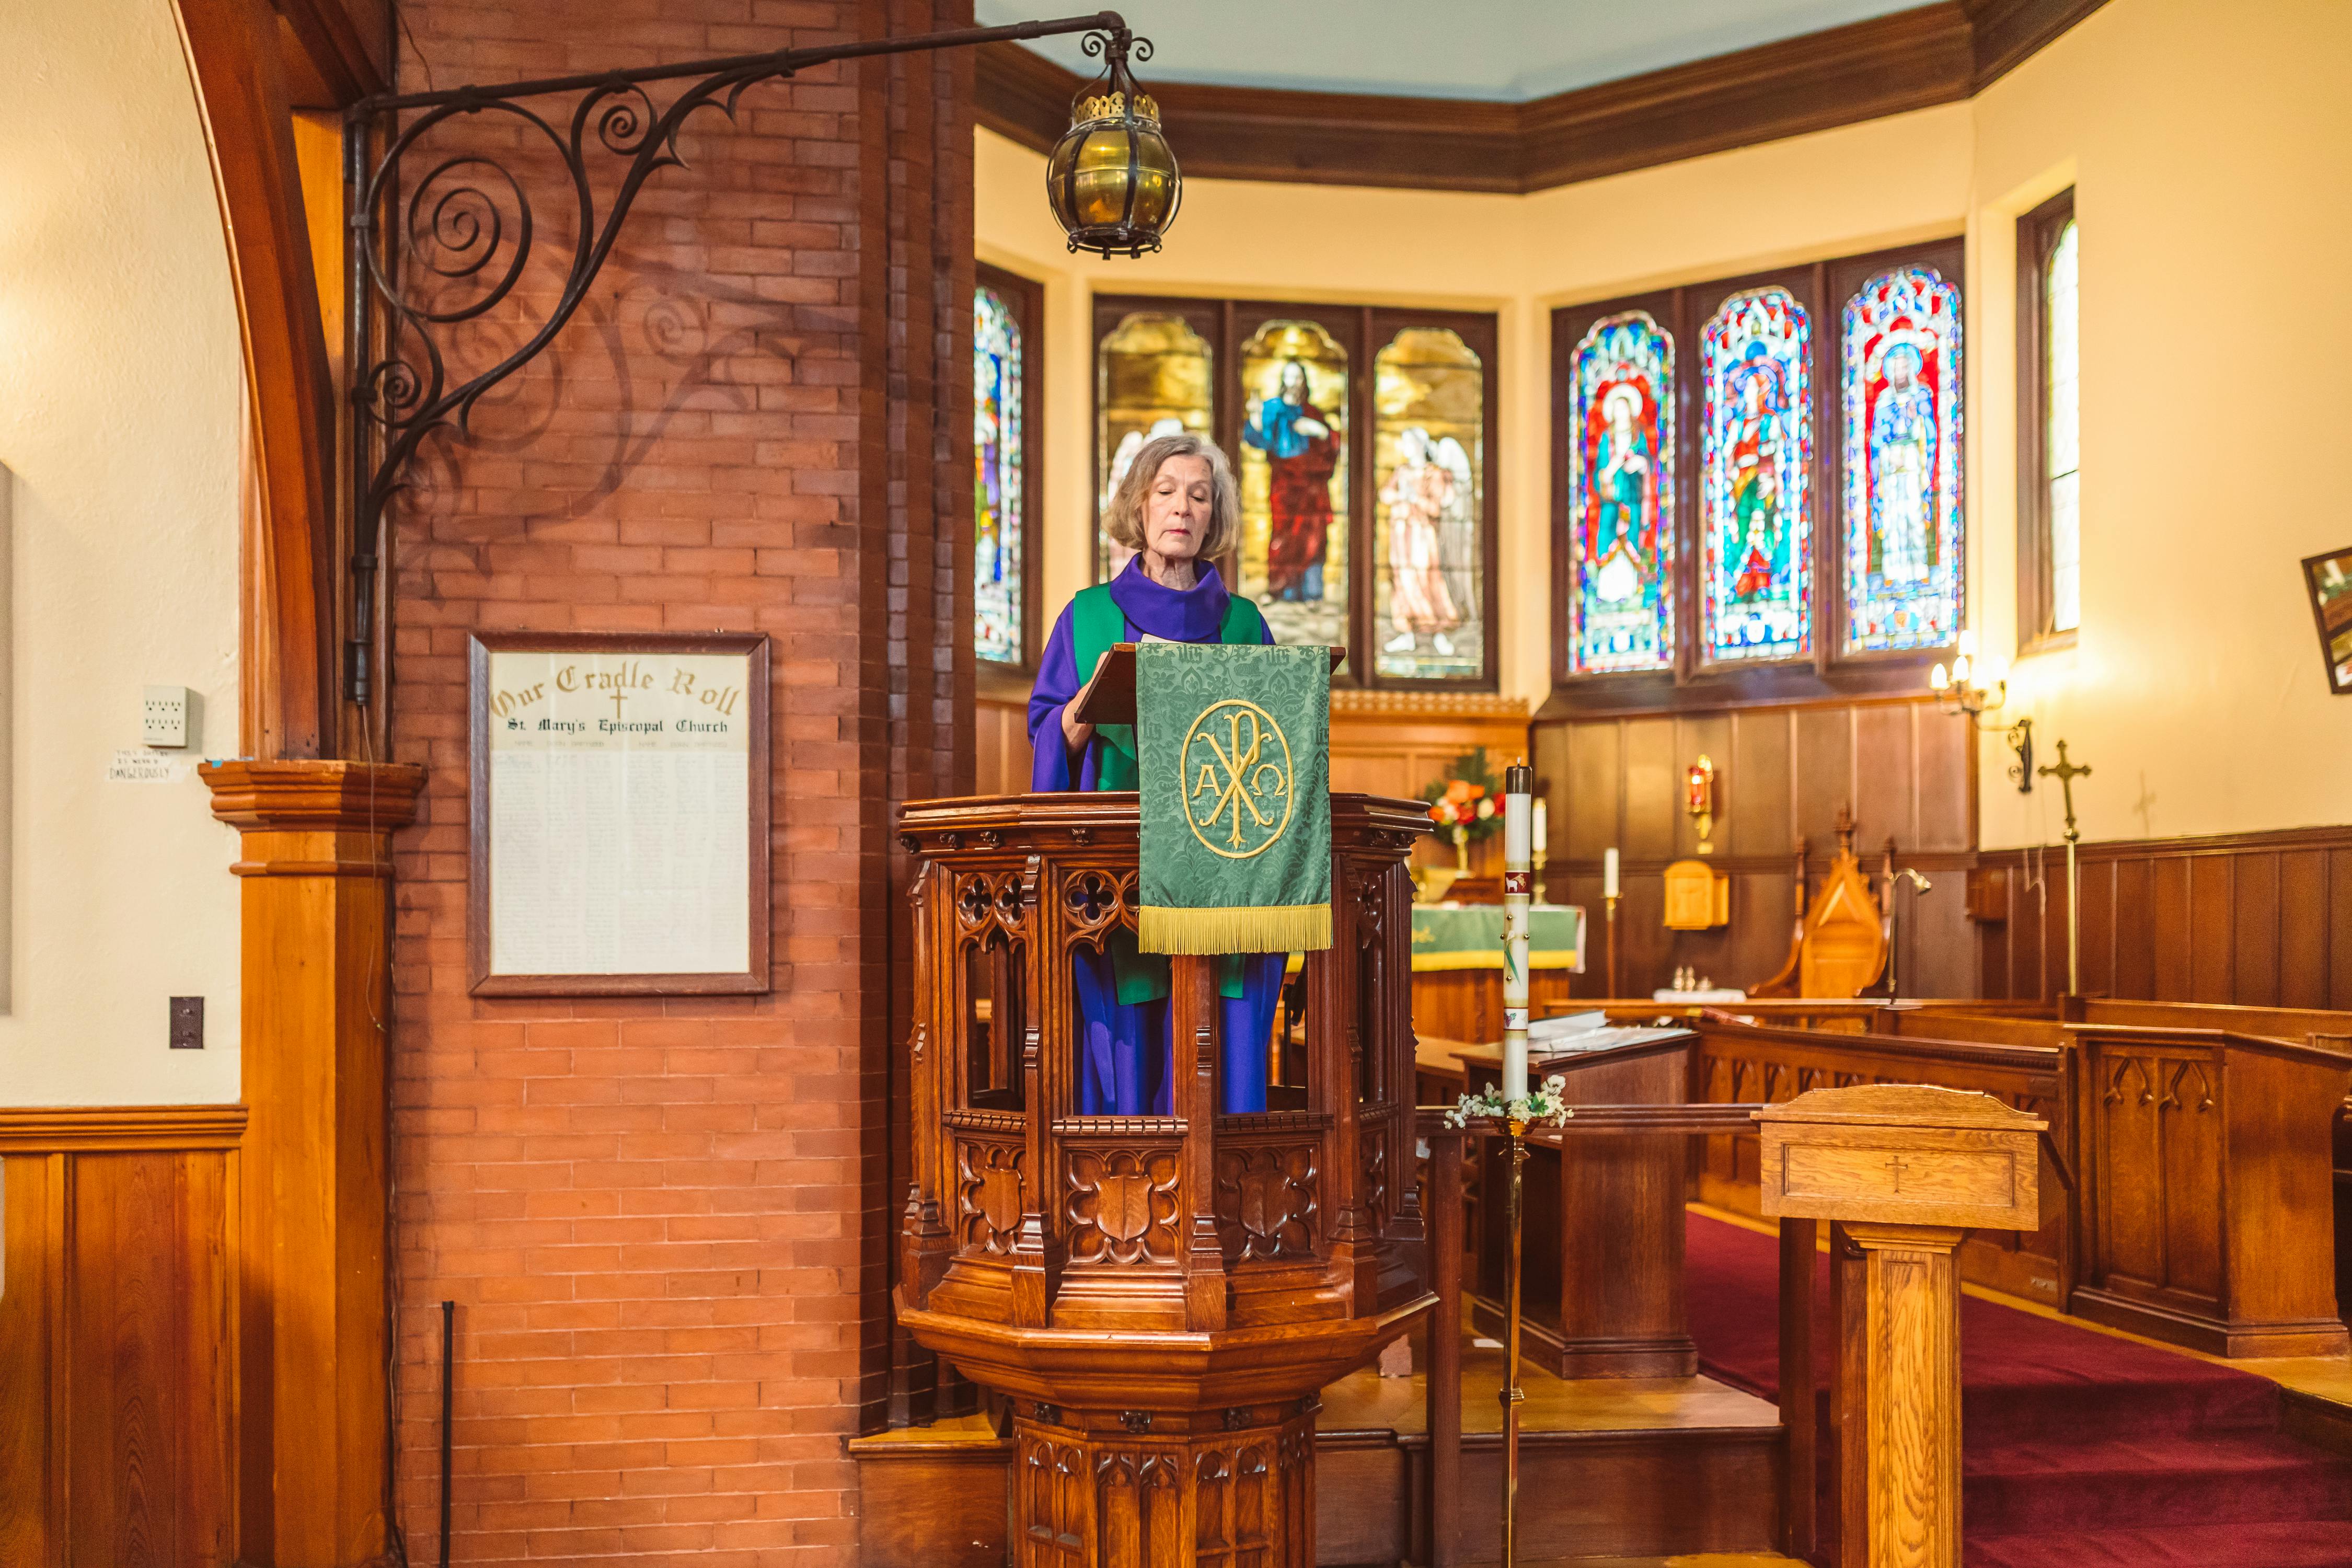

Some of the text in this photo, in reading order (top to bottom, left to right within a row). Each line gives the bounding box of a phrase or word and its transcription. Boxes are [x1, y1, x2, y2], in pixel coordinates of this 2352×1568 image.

[489, 661, 741, 719] Our Cradle Roll
[537, 719, 586, 735] Mary's
[598, 719, 663, 735] Episcopal
[675, 719, 728, 733] Church
